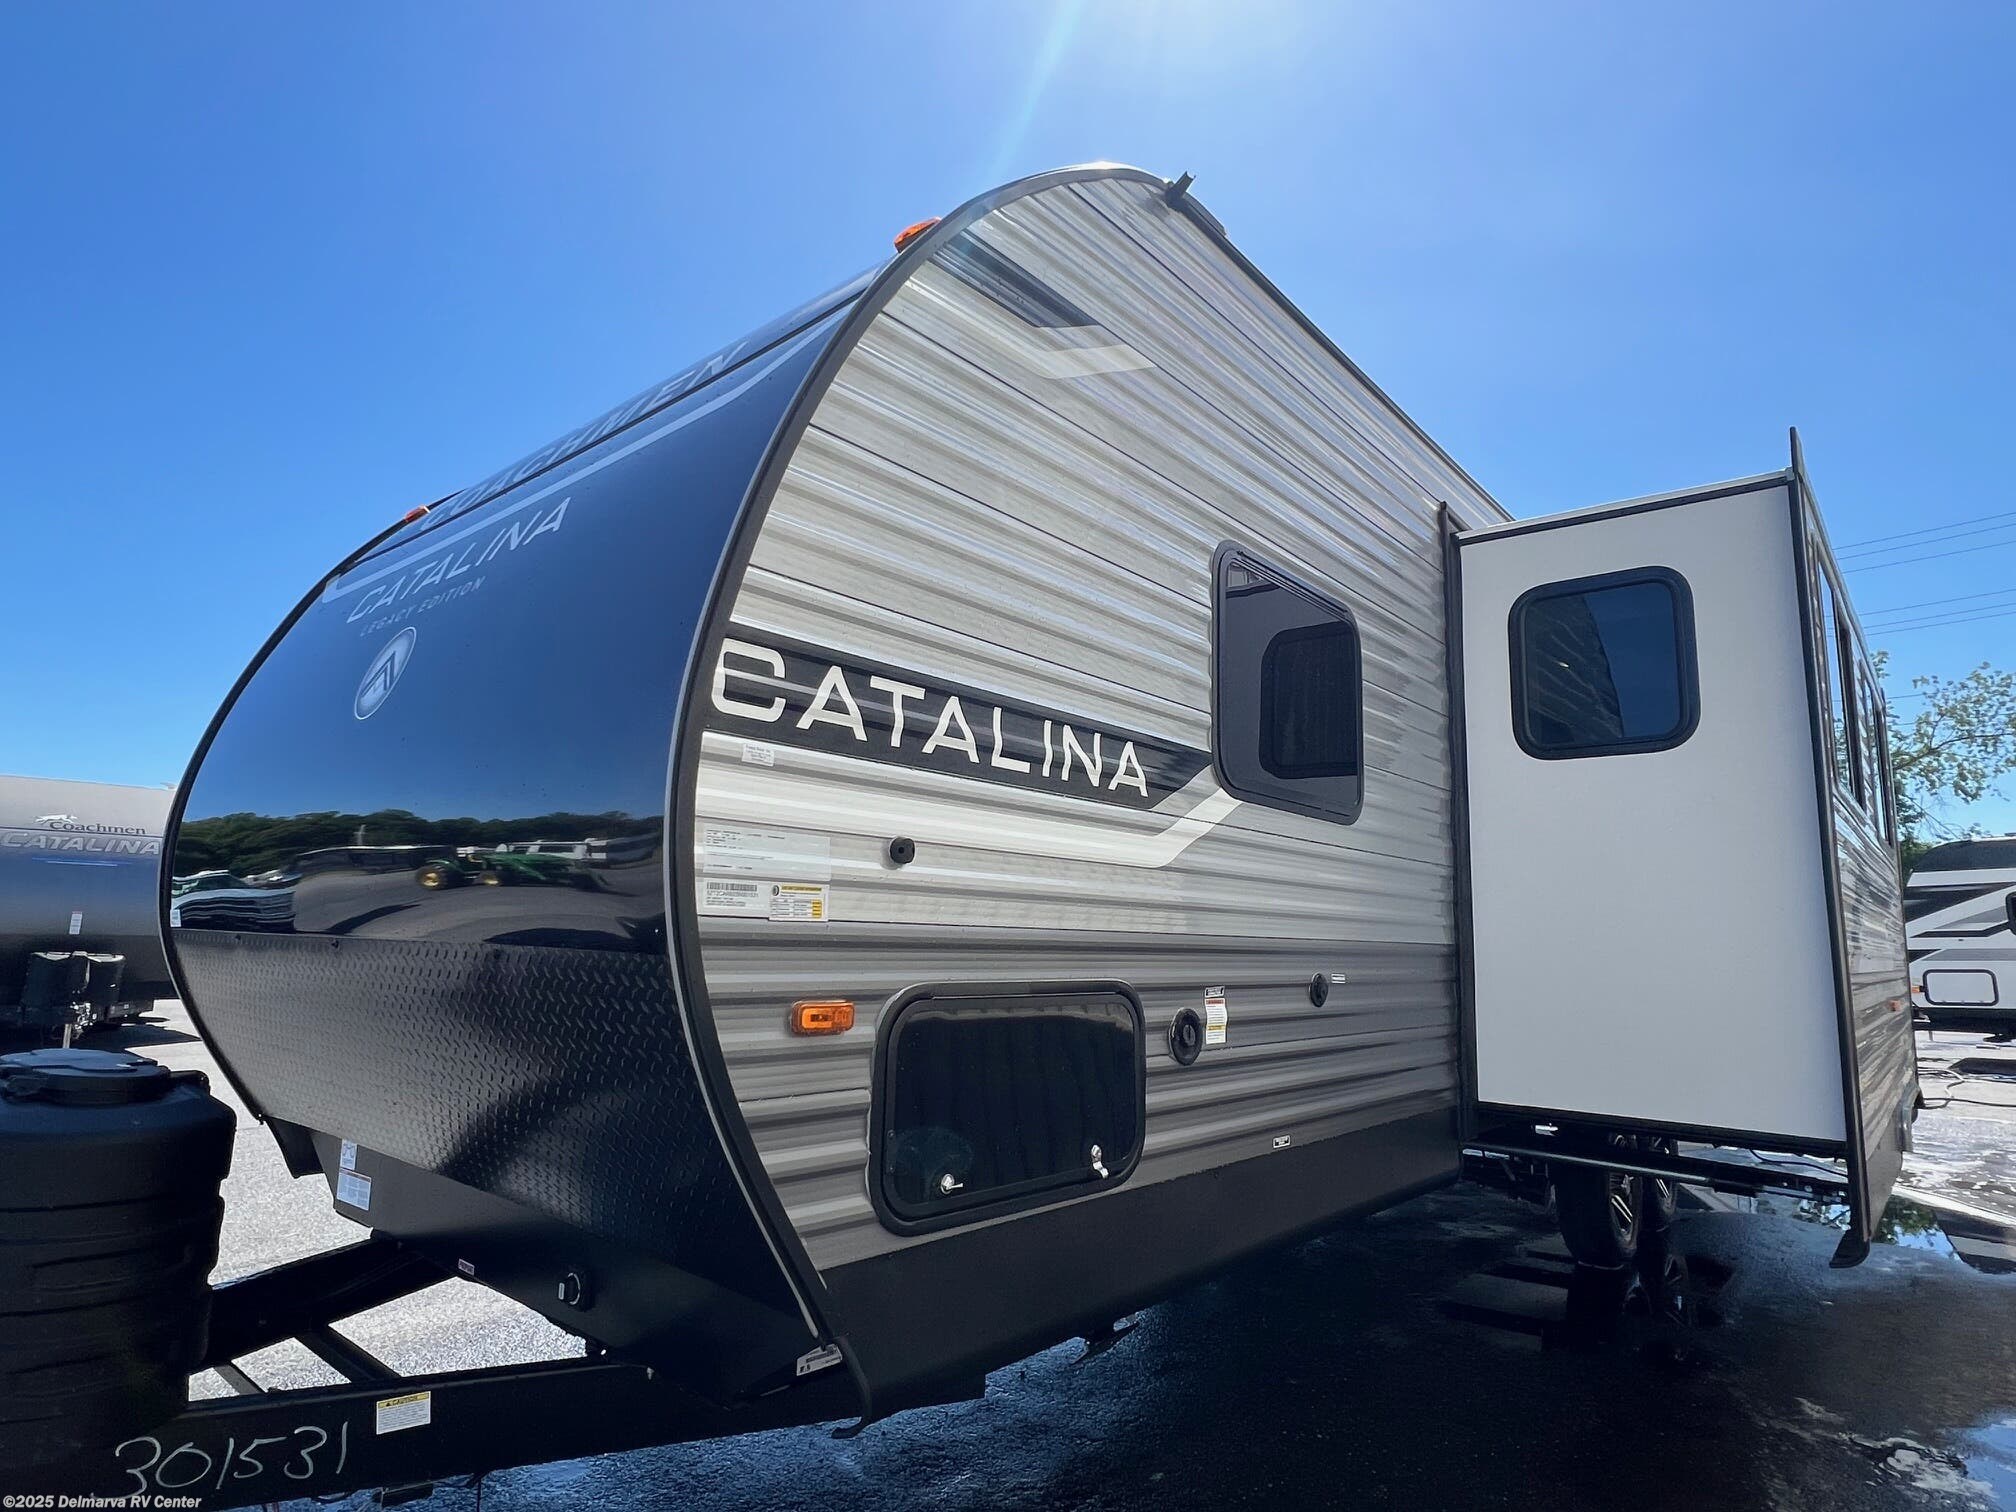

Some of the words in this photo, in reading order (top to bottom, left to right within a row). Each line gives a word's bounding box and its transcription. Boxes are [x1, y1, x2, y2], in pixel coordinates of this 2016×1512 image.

[347, 497, 571, 623] CATALINA
[417, 576, 486, 615] EDITION
[712, 638, 1149, 797] CATALINA
[1, 831, 160, 855] CATALINA
[50, 821, 146, 835] Coachmen
[90, 1421, 348, 1500] 301531
